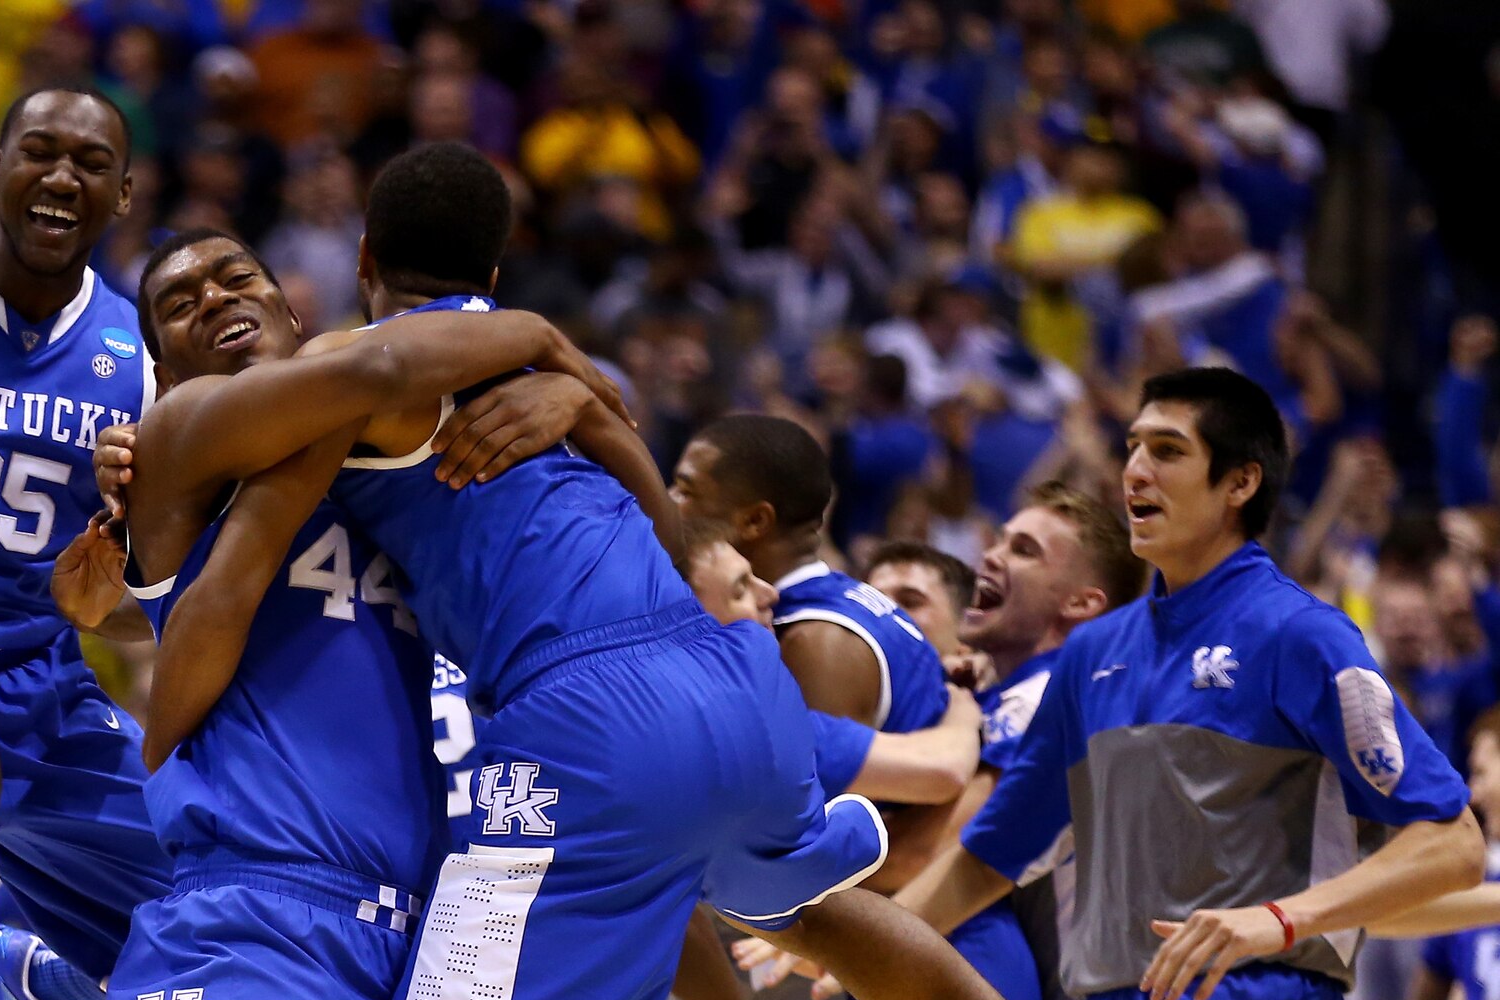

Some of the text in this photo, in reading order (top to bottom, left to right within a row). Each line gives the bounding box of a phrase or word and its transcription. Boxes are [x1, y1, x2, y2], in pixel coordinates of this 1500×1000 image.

[105, 337, 137, 354] NCAA
[93, 355, 115, 376] SEC
[1357, 747, 1397, 776] UK
[476, 762, 560, 837] UK
